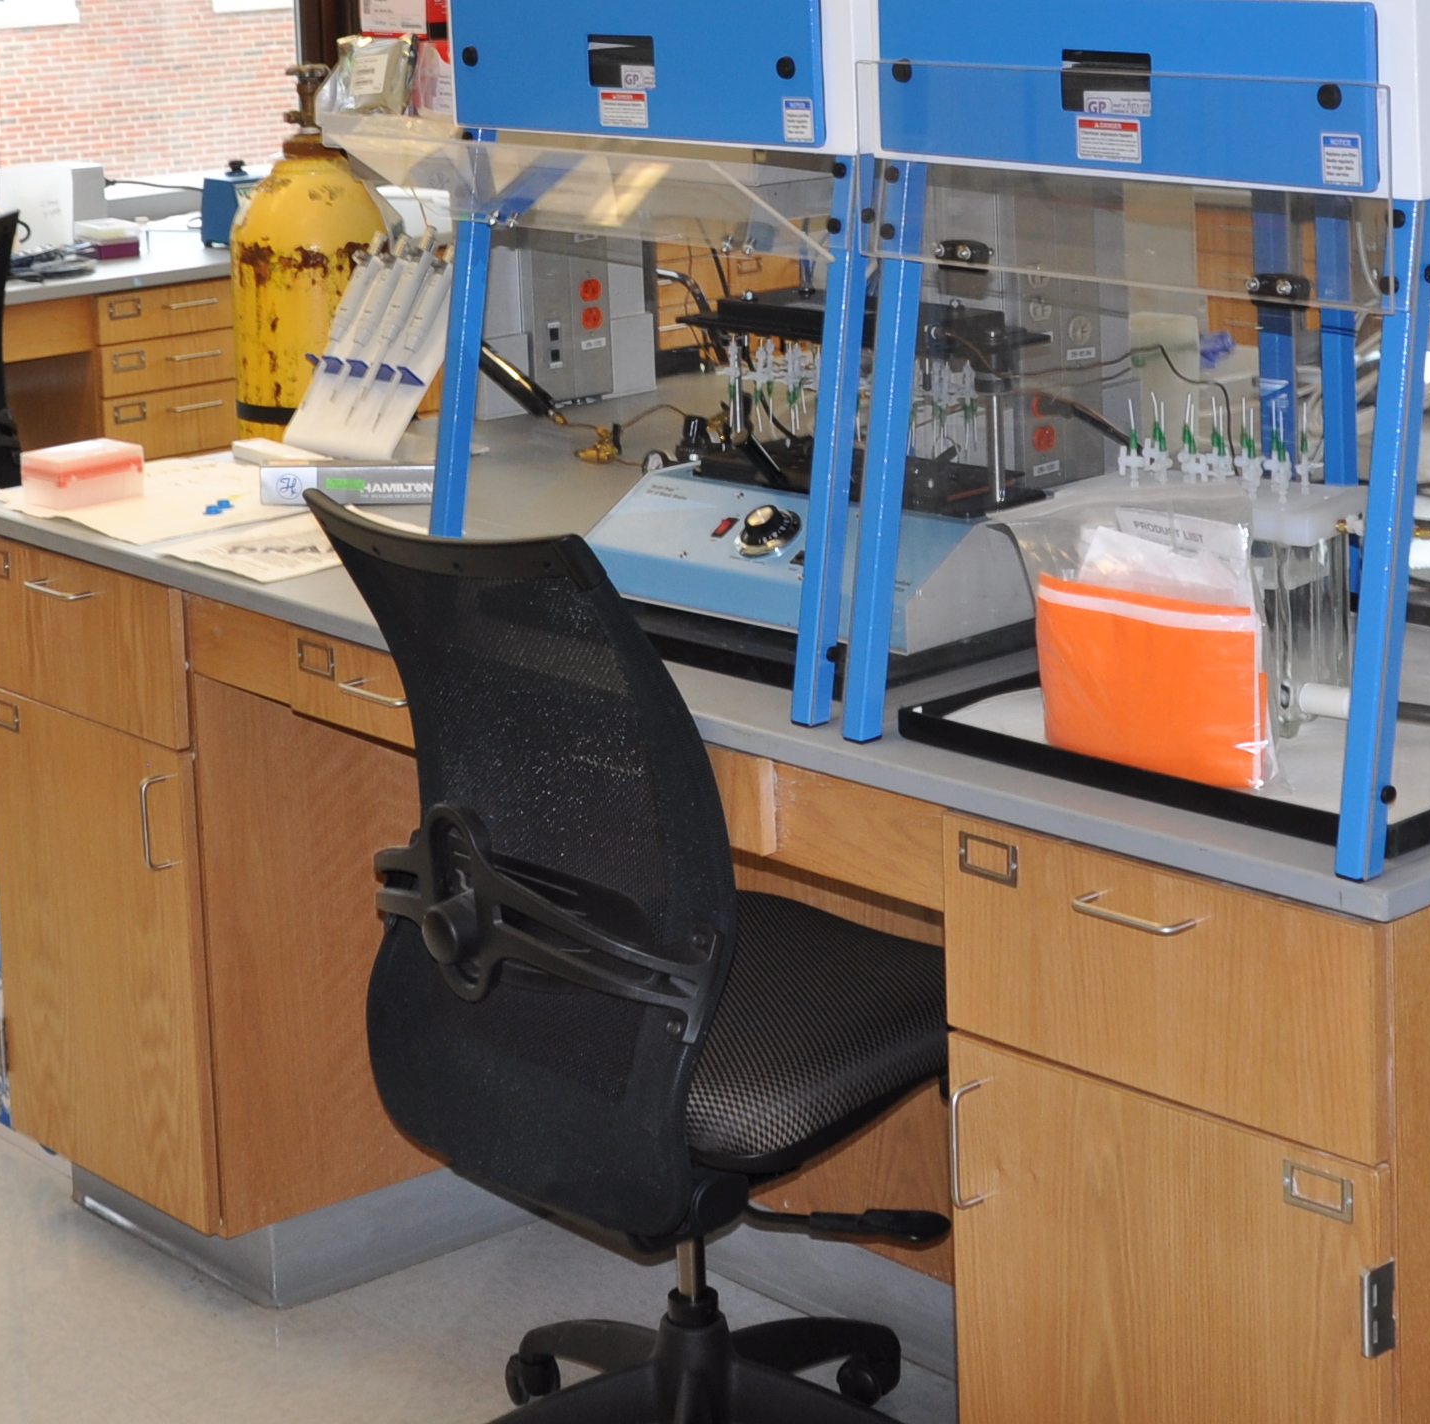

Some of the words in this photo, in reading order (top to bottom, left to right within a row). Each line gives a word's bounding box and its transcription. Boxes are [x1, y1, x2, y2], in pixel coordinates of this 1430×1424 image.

[624, 73, 639, 86] GP
[1087, 101, 1107, 114] GP
[360, 482, 434, 494] HAMILTON
[1183, 531, 1204, 543] LIST
